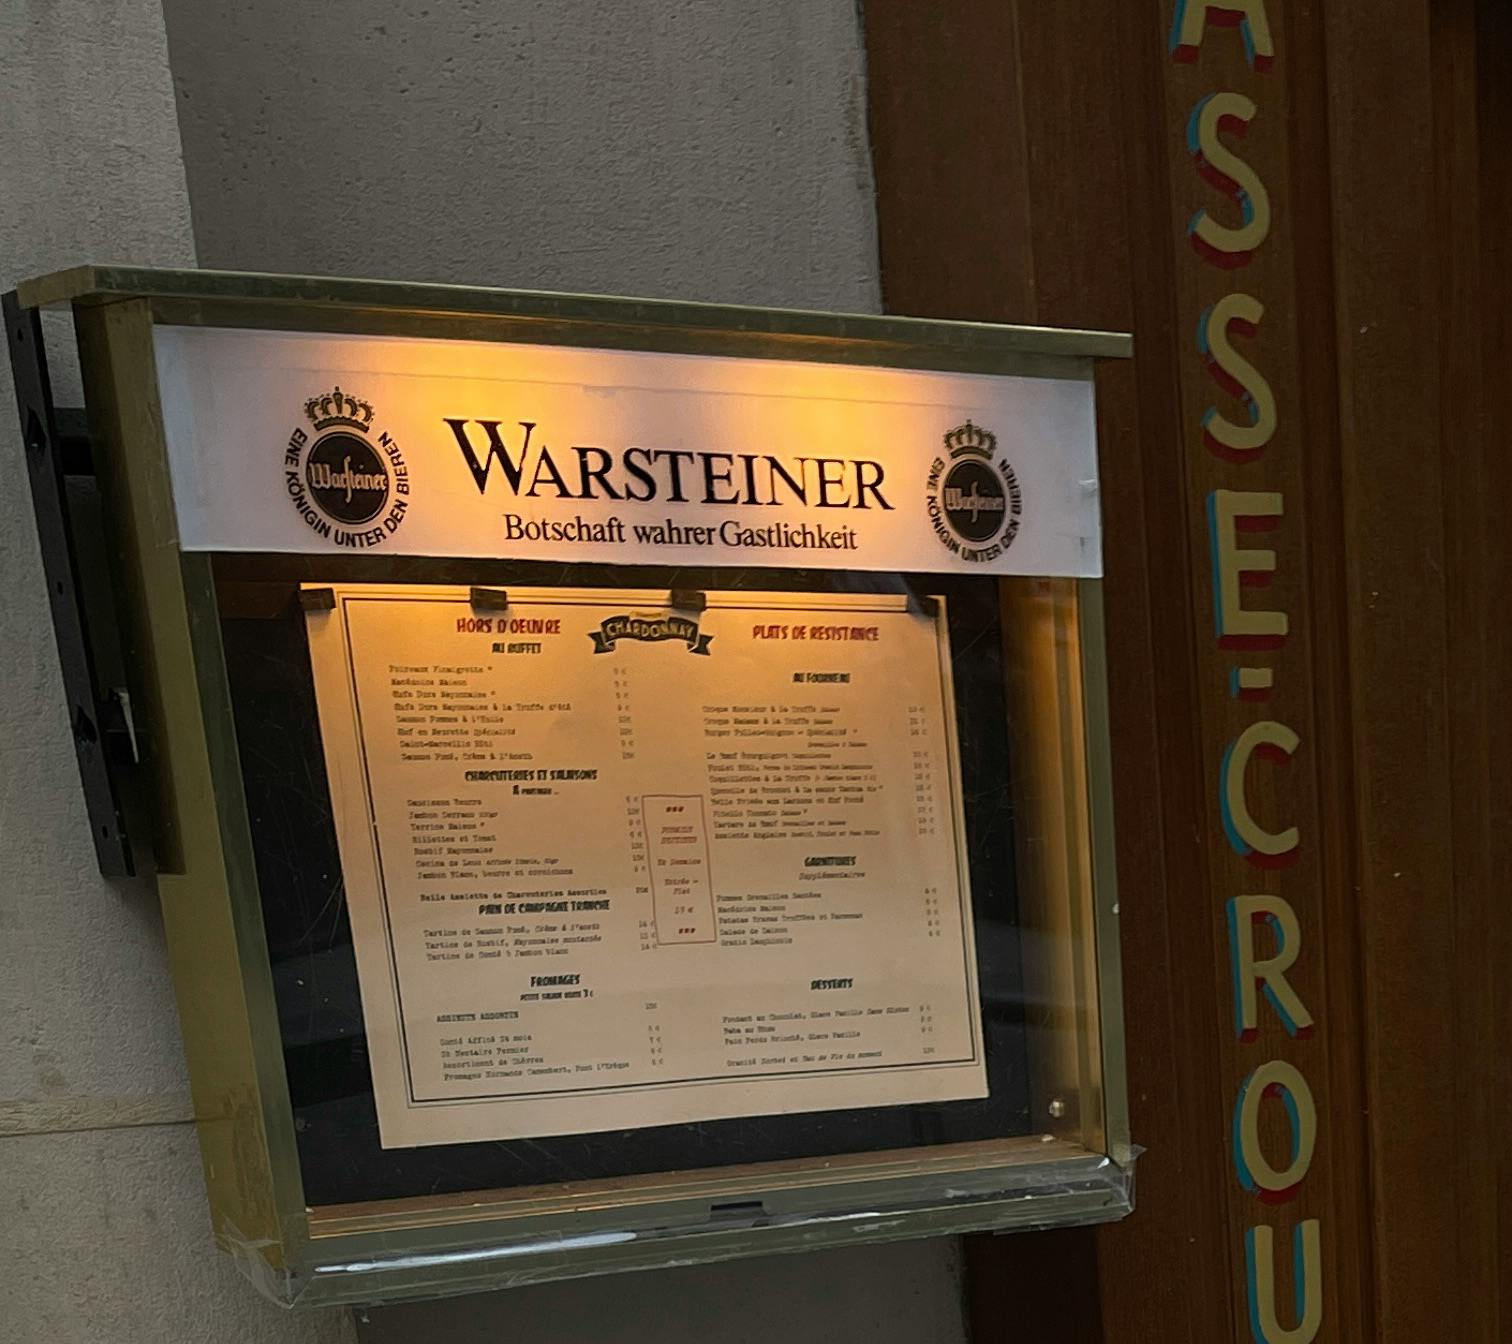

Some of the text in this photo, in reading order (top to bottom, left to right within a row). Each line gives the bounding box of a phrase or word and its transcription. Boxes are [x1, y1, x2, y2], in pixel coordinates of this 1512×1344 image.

[443, 417, 895, 510] WARSTEINER
[284, 428, 409, 549] EINE KÖNIGIN UNTER DEN BIEREN
[504, 512, 858, 550] Botschaft wahrer Gastlichkeit
[457, 618, 492, 632] HORS
[606, 621, 694, 639] CHARDONNAY
[753, 625, 787, 639] PLATS
[792, 626, 806, 639] DE
[505, 903, 515, 913] DE
[530, 974, 580, 987] FROMAGES
[811, 979, 853, 990] DESSERTS
